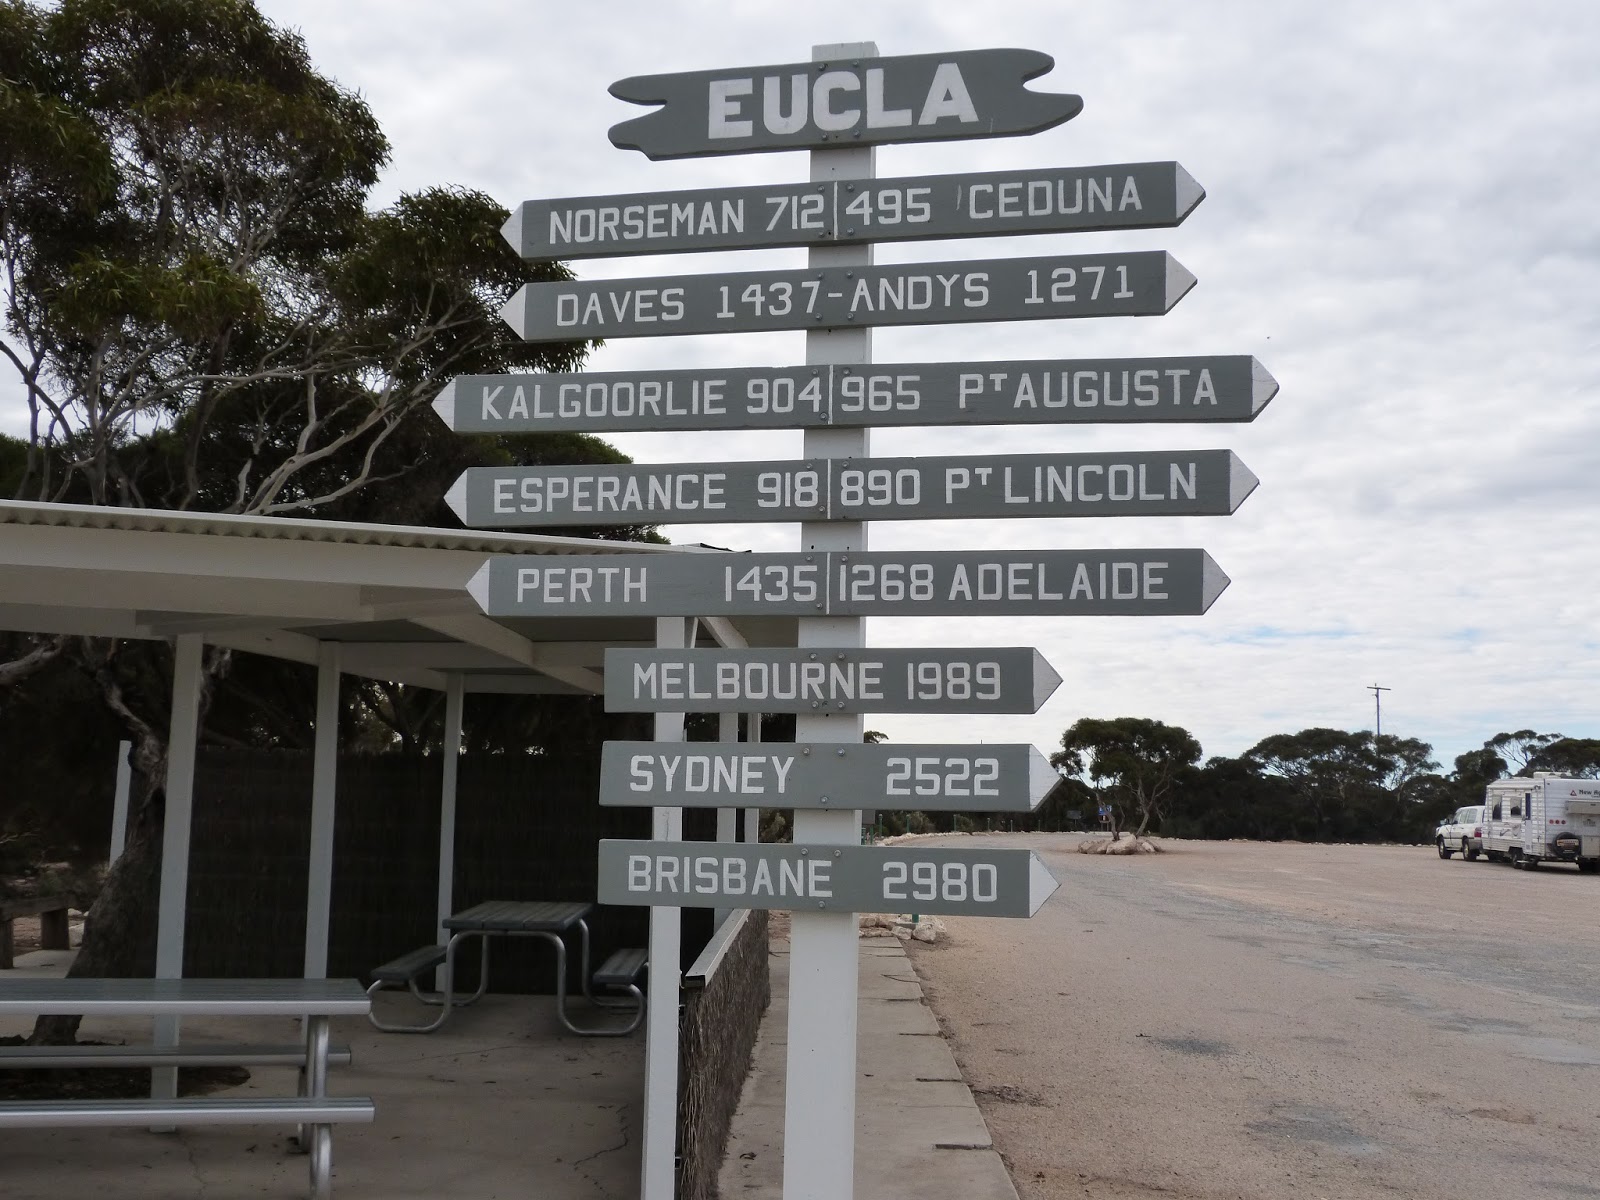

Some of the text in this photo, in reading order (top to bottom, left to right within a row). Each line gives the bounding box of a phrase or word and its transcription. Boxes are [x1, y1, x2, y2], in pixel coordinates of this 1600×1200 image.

[708, 62, 979, 139] EUCLA
[549, 194, 825, 245] NORSEMAN 712
[845, 176, 1143, 226] 495 CEDUNA
[556, 288, 685, 326] DAVES
[1024, 265, 1135, 304] 1271
[481, 377, 822, 421] KALGOORLIE 904
[841, 375, 921, 412] 965
[1013, 368, 1218, 409] AUGUSTA
[494, 470, 819, 513] ESPERANCE 918
[840, 469, 921, 506] 890
[1004, 463, 1197, 504] LINCOLN
[516, 565, 818, 603] PERTH 1435
[839, 562, 1169, 601] 1268 ADELAIDE
[632, 661, 1001, 701] MELBOURNE 1989
[629, 755, 1000, 796] SYDNEY 2522
[628, 855, 998, 902] BRISBANE 2980
